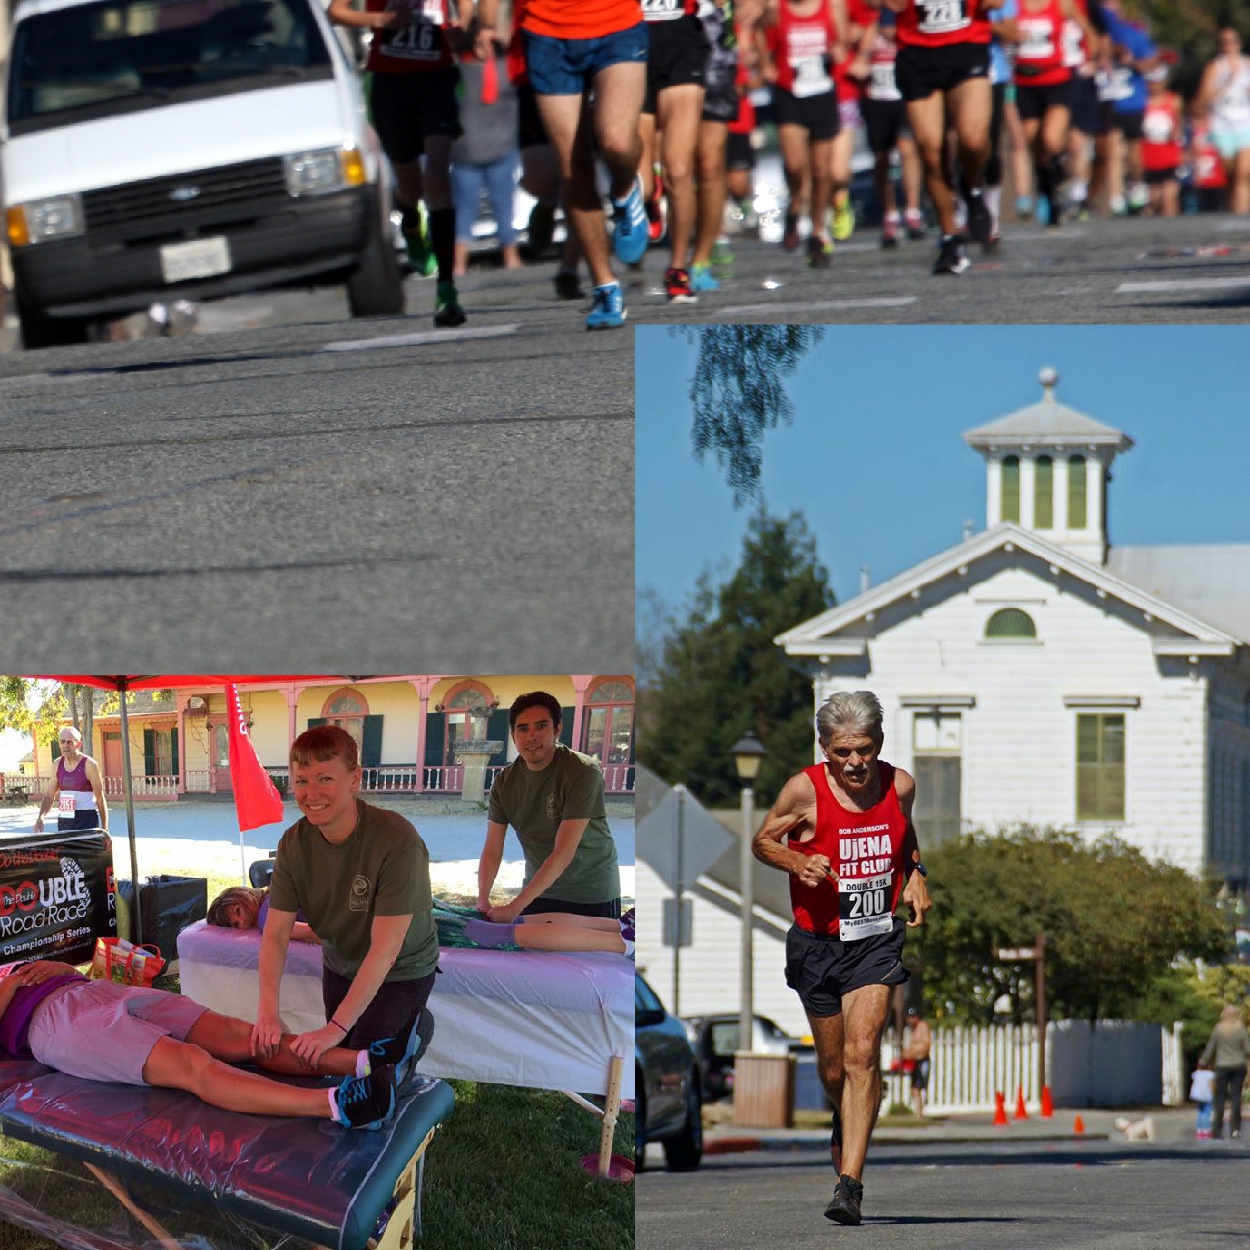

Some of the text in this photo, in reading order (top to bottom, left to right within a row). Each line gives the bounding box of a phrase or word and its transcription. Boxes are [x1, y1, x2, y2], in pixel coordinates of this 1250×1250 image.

[839, 861, 858, 877] FIT
[846, 878, 887, 891] DOUBLE 15K
[849, 889, 885, 918] 200
[0, 907, 45, 937] Road
[47, 902, 87, 926] Race
[3, 932, 65, 956] Championship
[66, 926, 91, 939] Series
